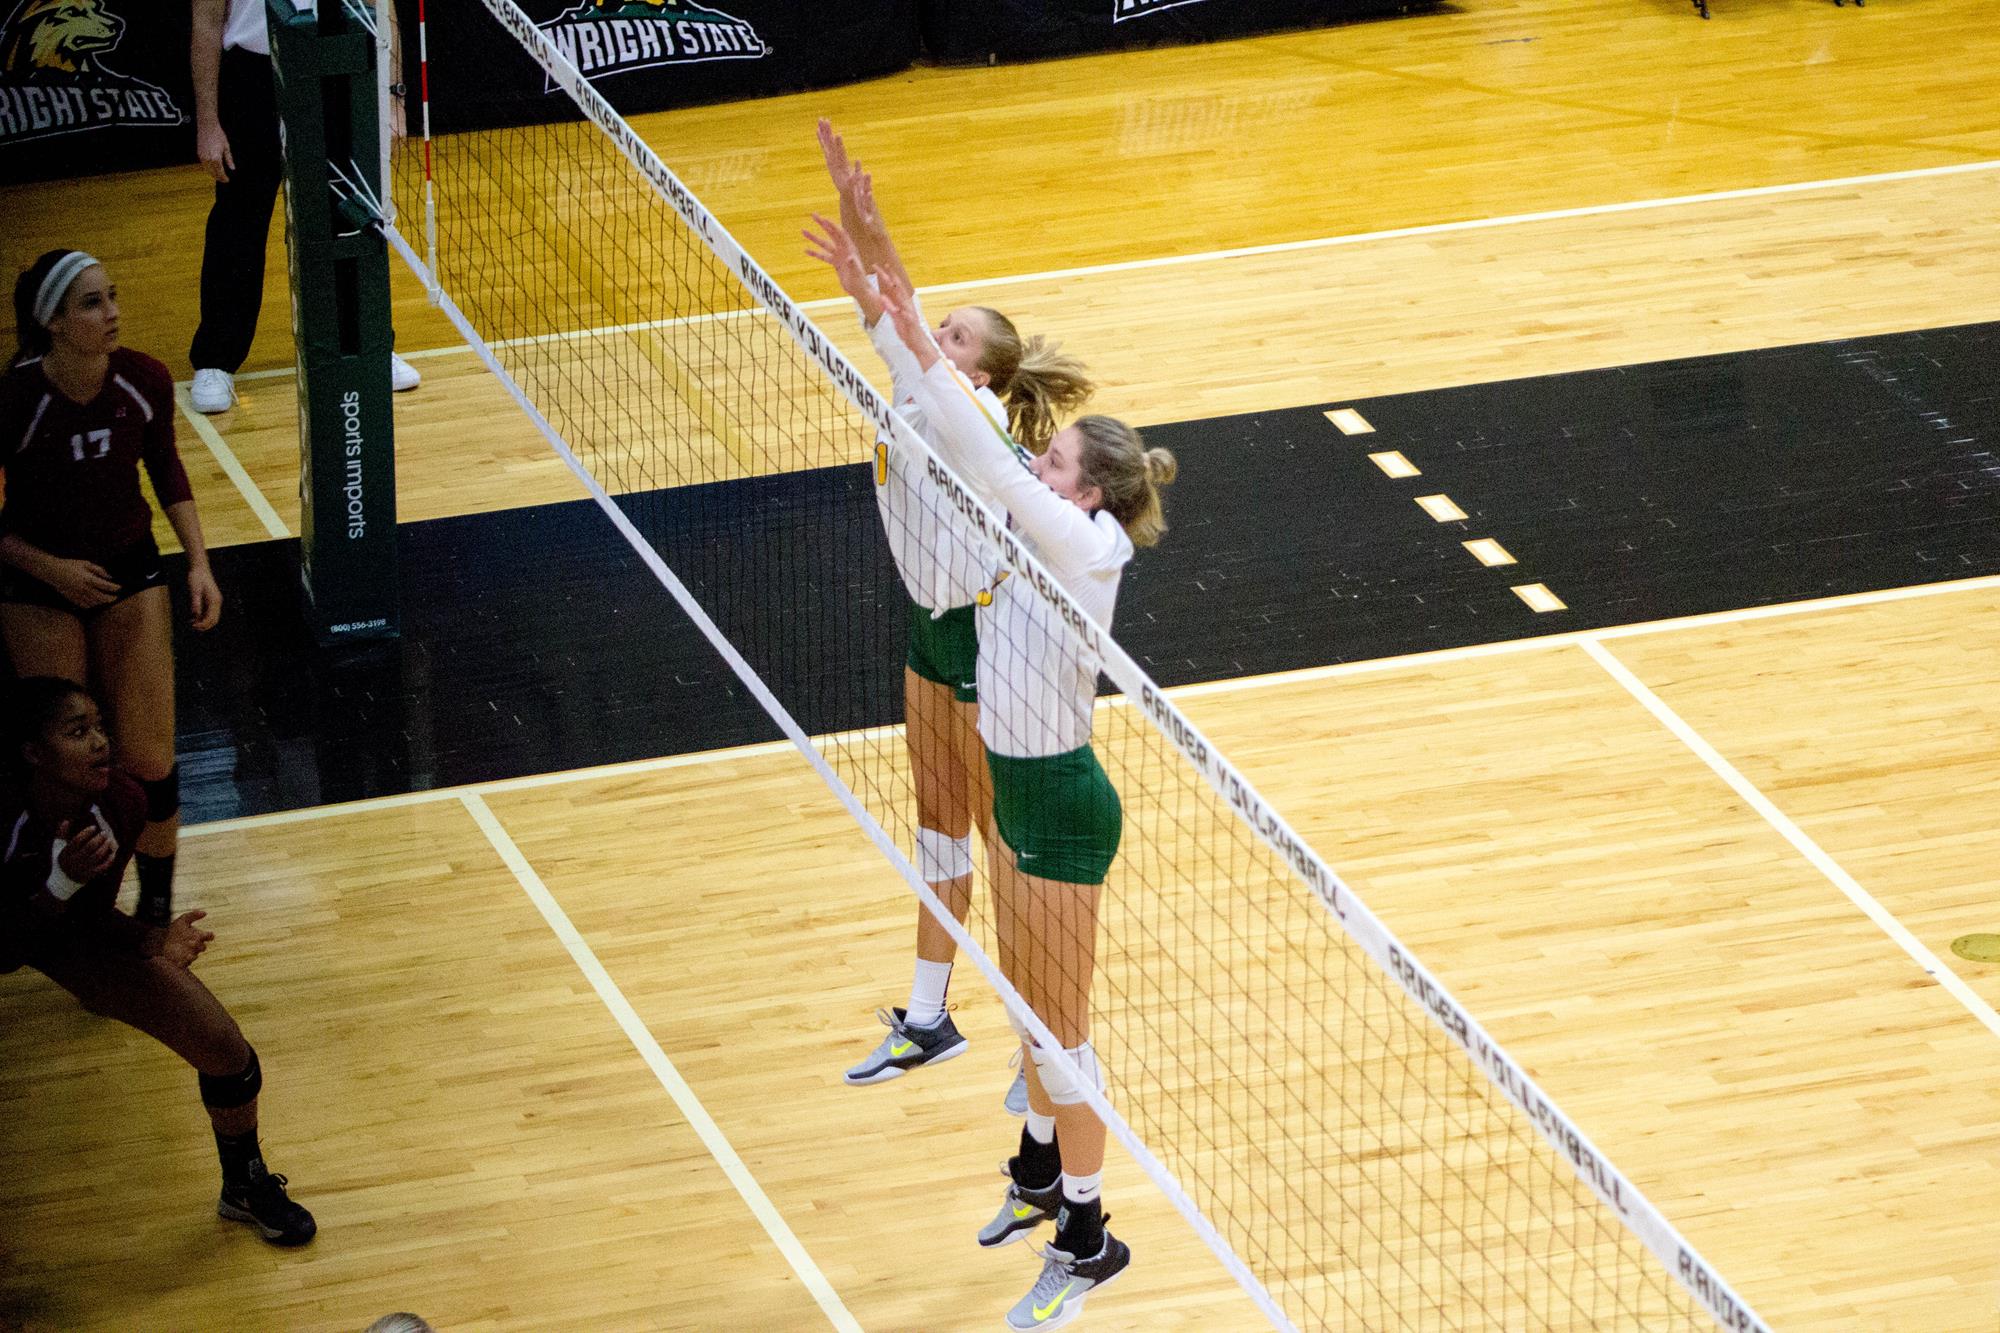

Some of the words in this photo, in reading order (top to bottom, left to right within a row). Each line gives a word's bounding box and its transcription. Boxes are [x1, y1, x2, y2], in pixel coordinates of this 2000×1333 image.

[542, 20, 675, 71] WRIGHT
[677, 20, 760, 55] STATE
[0, 86, 88, 136] RIGHT
[90, 88, 176, 119] STATE
[70, 428, 112, 461] 17
[340, 391, 363, 457] sports
[343, 459, 367, 539] imports
[927, 455, 987, 537] RAIDER
[1142, 683, 1208, 773] RAIDER
[1388, 944, 1470, 1047] RAIDER
[1678, 1246, 1766, 1333] RAIDE
